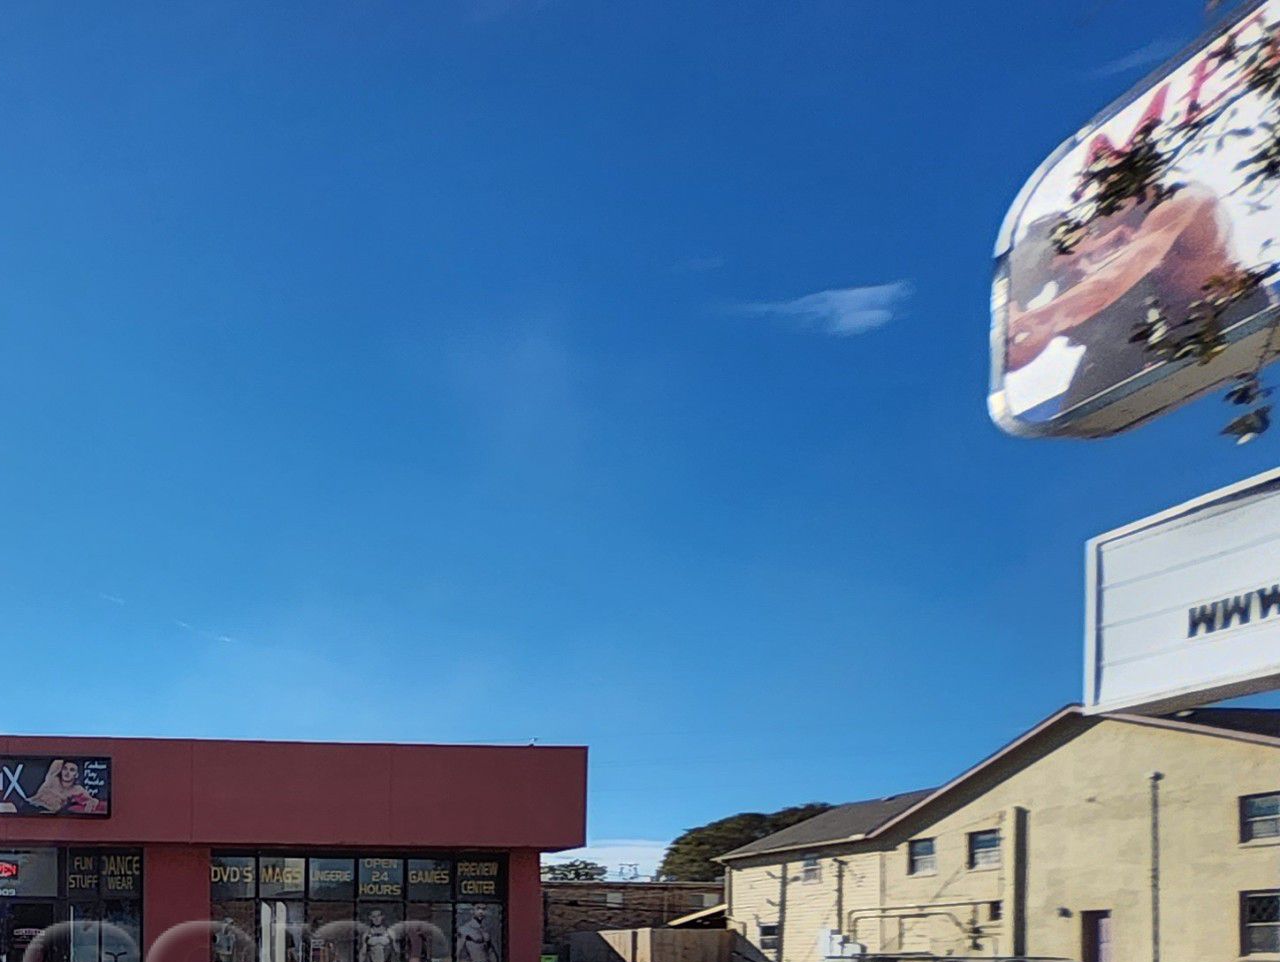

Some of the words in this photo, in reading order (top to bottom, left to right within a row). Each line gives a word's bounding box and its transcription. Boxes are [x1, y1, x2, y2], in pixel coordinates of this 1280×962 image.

[74, 856, 93, 871] FUN
[102, 855, 140, 875] DANCE
[363, 858, 397, 869] OPEN
[458, 861, 498, 877] PREVIEW
[69, 874, 98, 888] STUFF
[211, 866, 254, 883] DVD'S
[262, 866, 302, 882] MAGS
[312, 870, 352, 882] LINGERIE
[372, 871, 389, 882] 24
[409, 870, 449, 884] GAMES
[107, 877, 134, 890] WEAR
[359, 884, 402, 896] HOURS
[461, 880, 495, 895] CENTER
